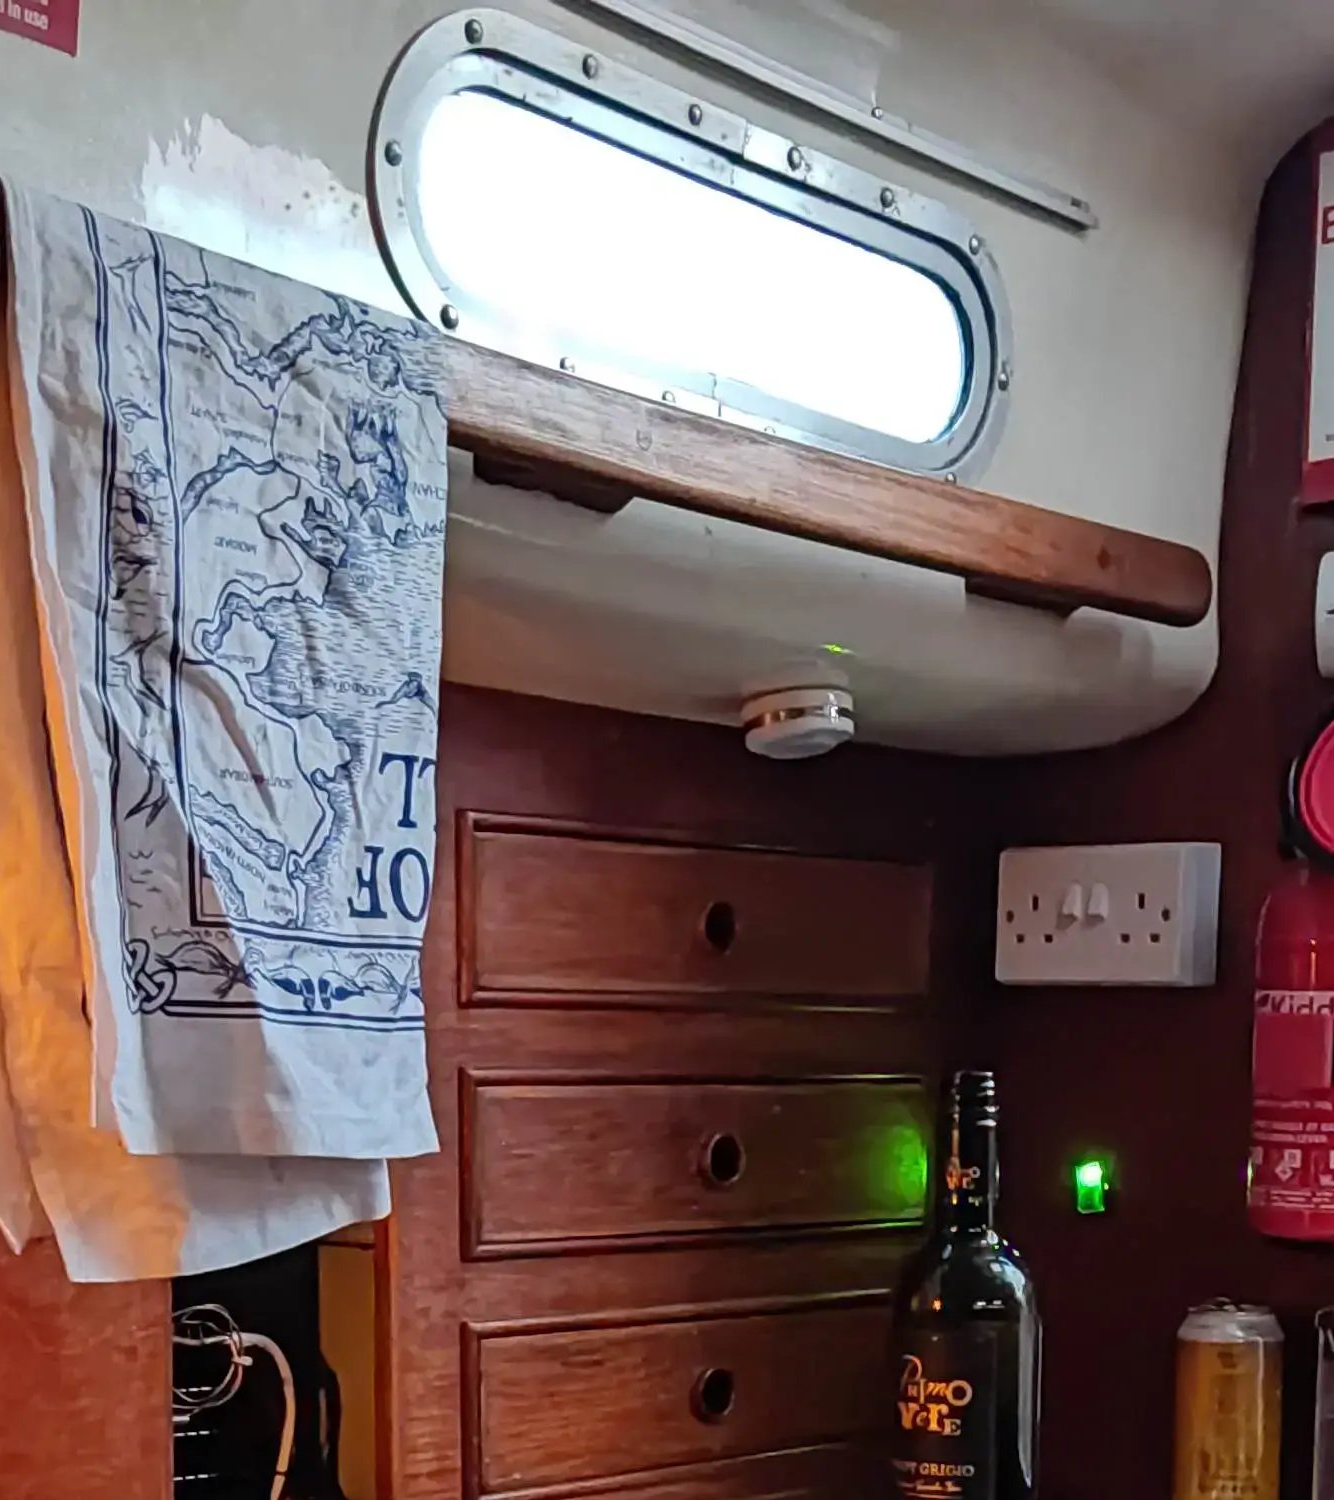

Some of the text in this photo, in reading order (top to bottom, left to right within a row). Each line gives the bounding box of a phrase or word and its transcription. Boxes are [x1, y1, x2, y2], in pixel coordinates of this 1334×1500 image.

[24, 8, 48, 30] use
[347, 845, 430, 923] OF
[919, 1462, 976, 1477] GRIGIO
